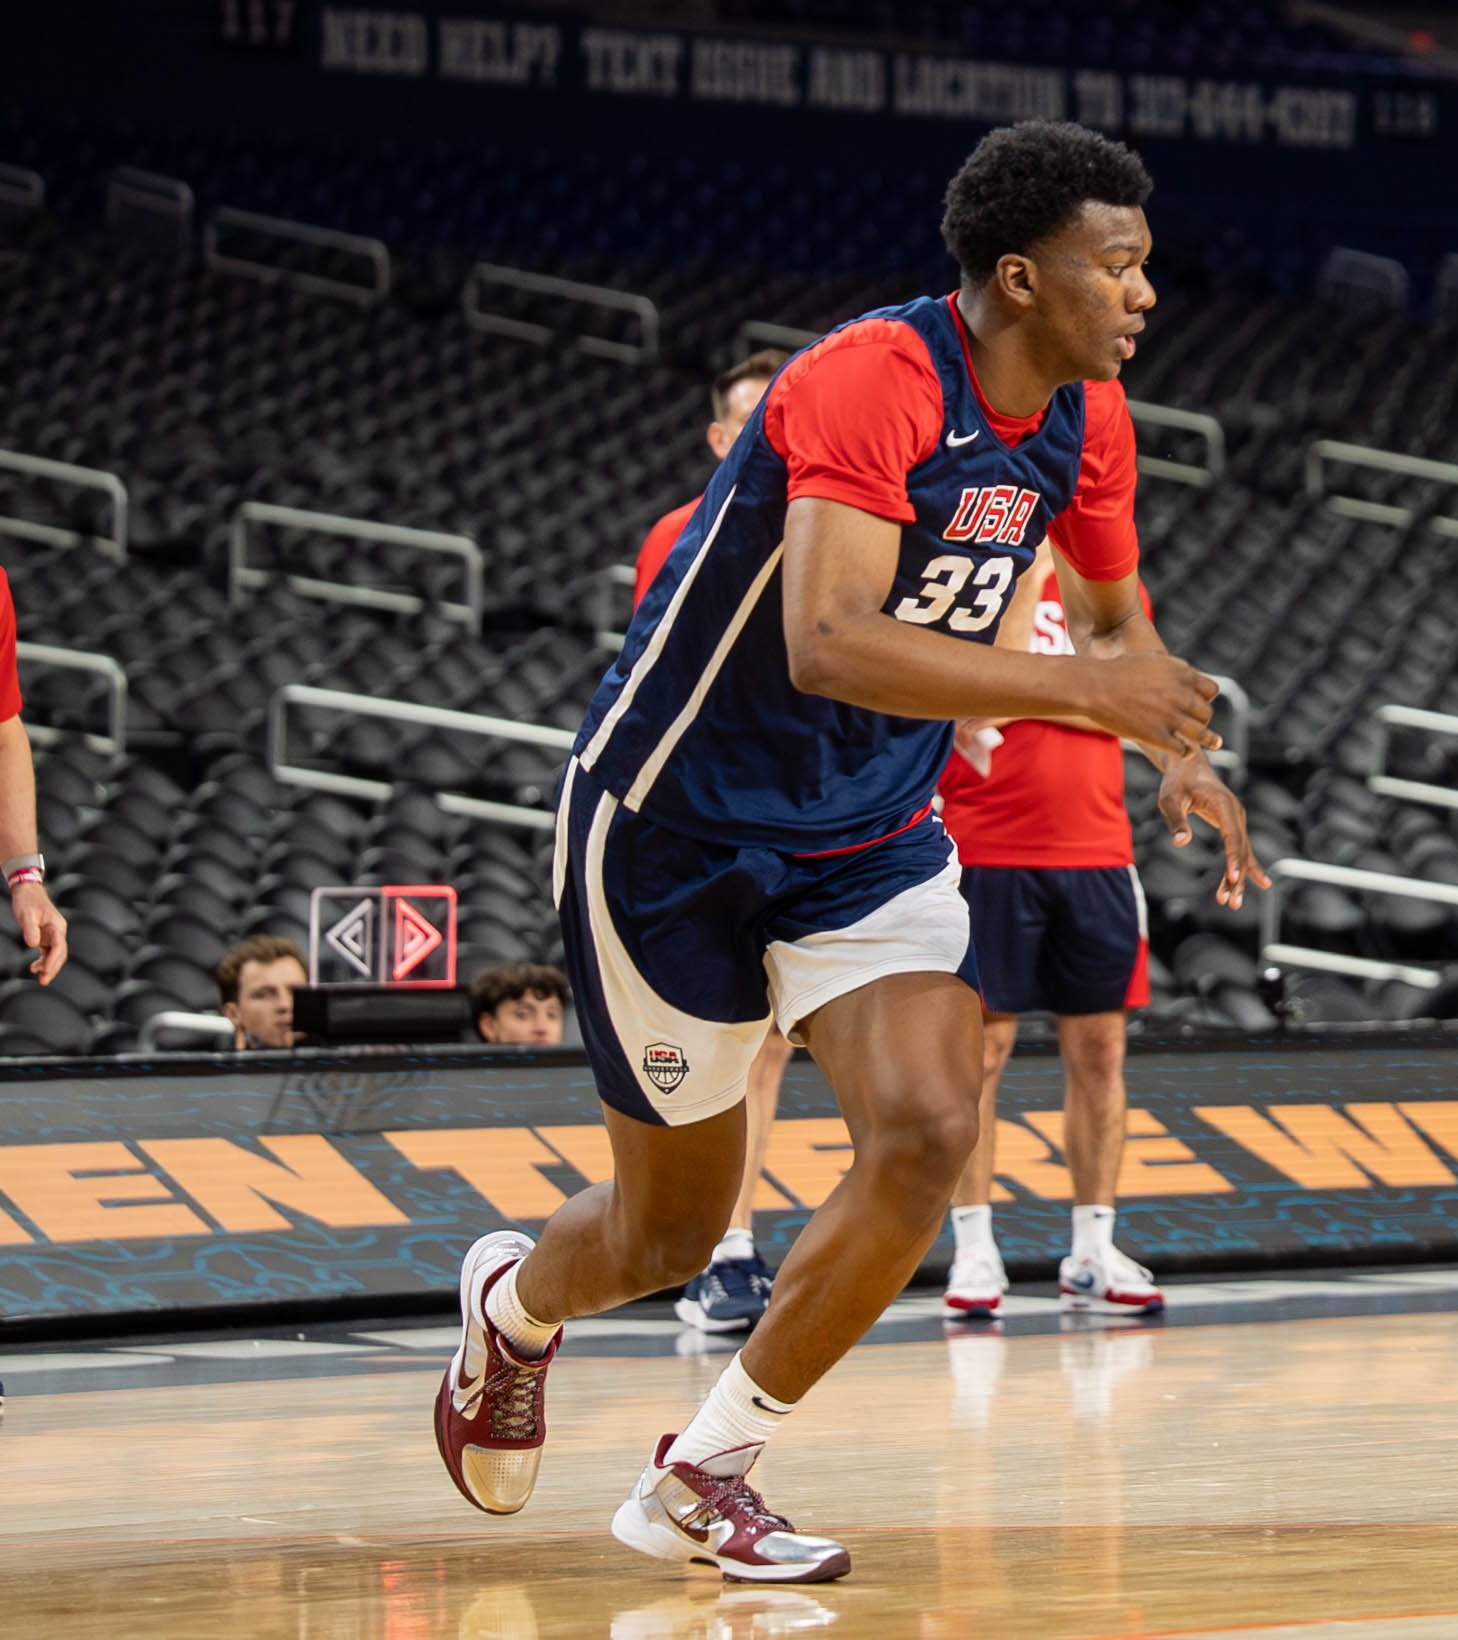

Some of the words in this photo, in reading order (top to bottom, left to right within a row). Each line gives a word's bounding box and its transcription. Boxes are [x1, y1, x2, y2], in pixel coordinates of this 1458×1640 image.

[318, 4, 429, 77] NEED
[435, 14, 563, 88] HELP?
[943, 485, 1040, 546] USA
[894, 555, 1014, 632] 33
[649, 1050, 679, 1063] USA
[0, 1133, 411, 1245] EN
